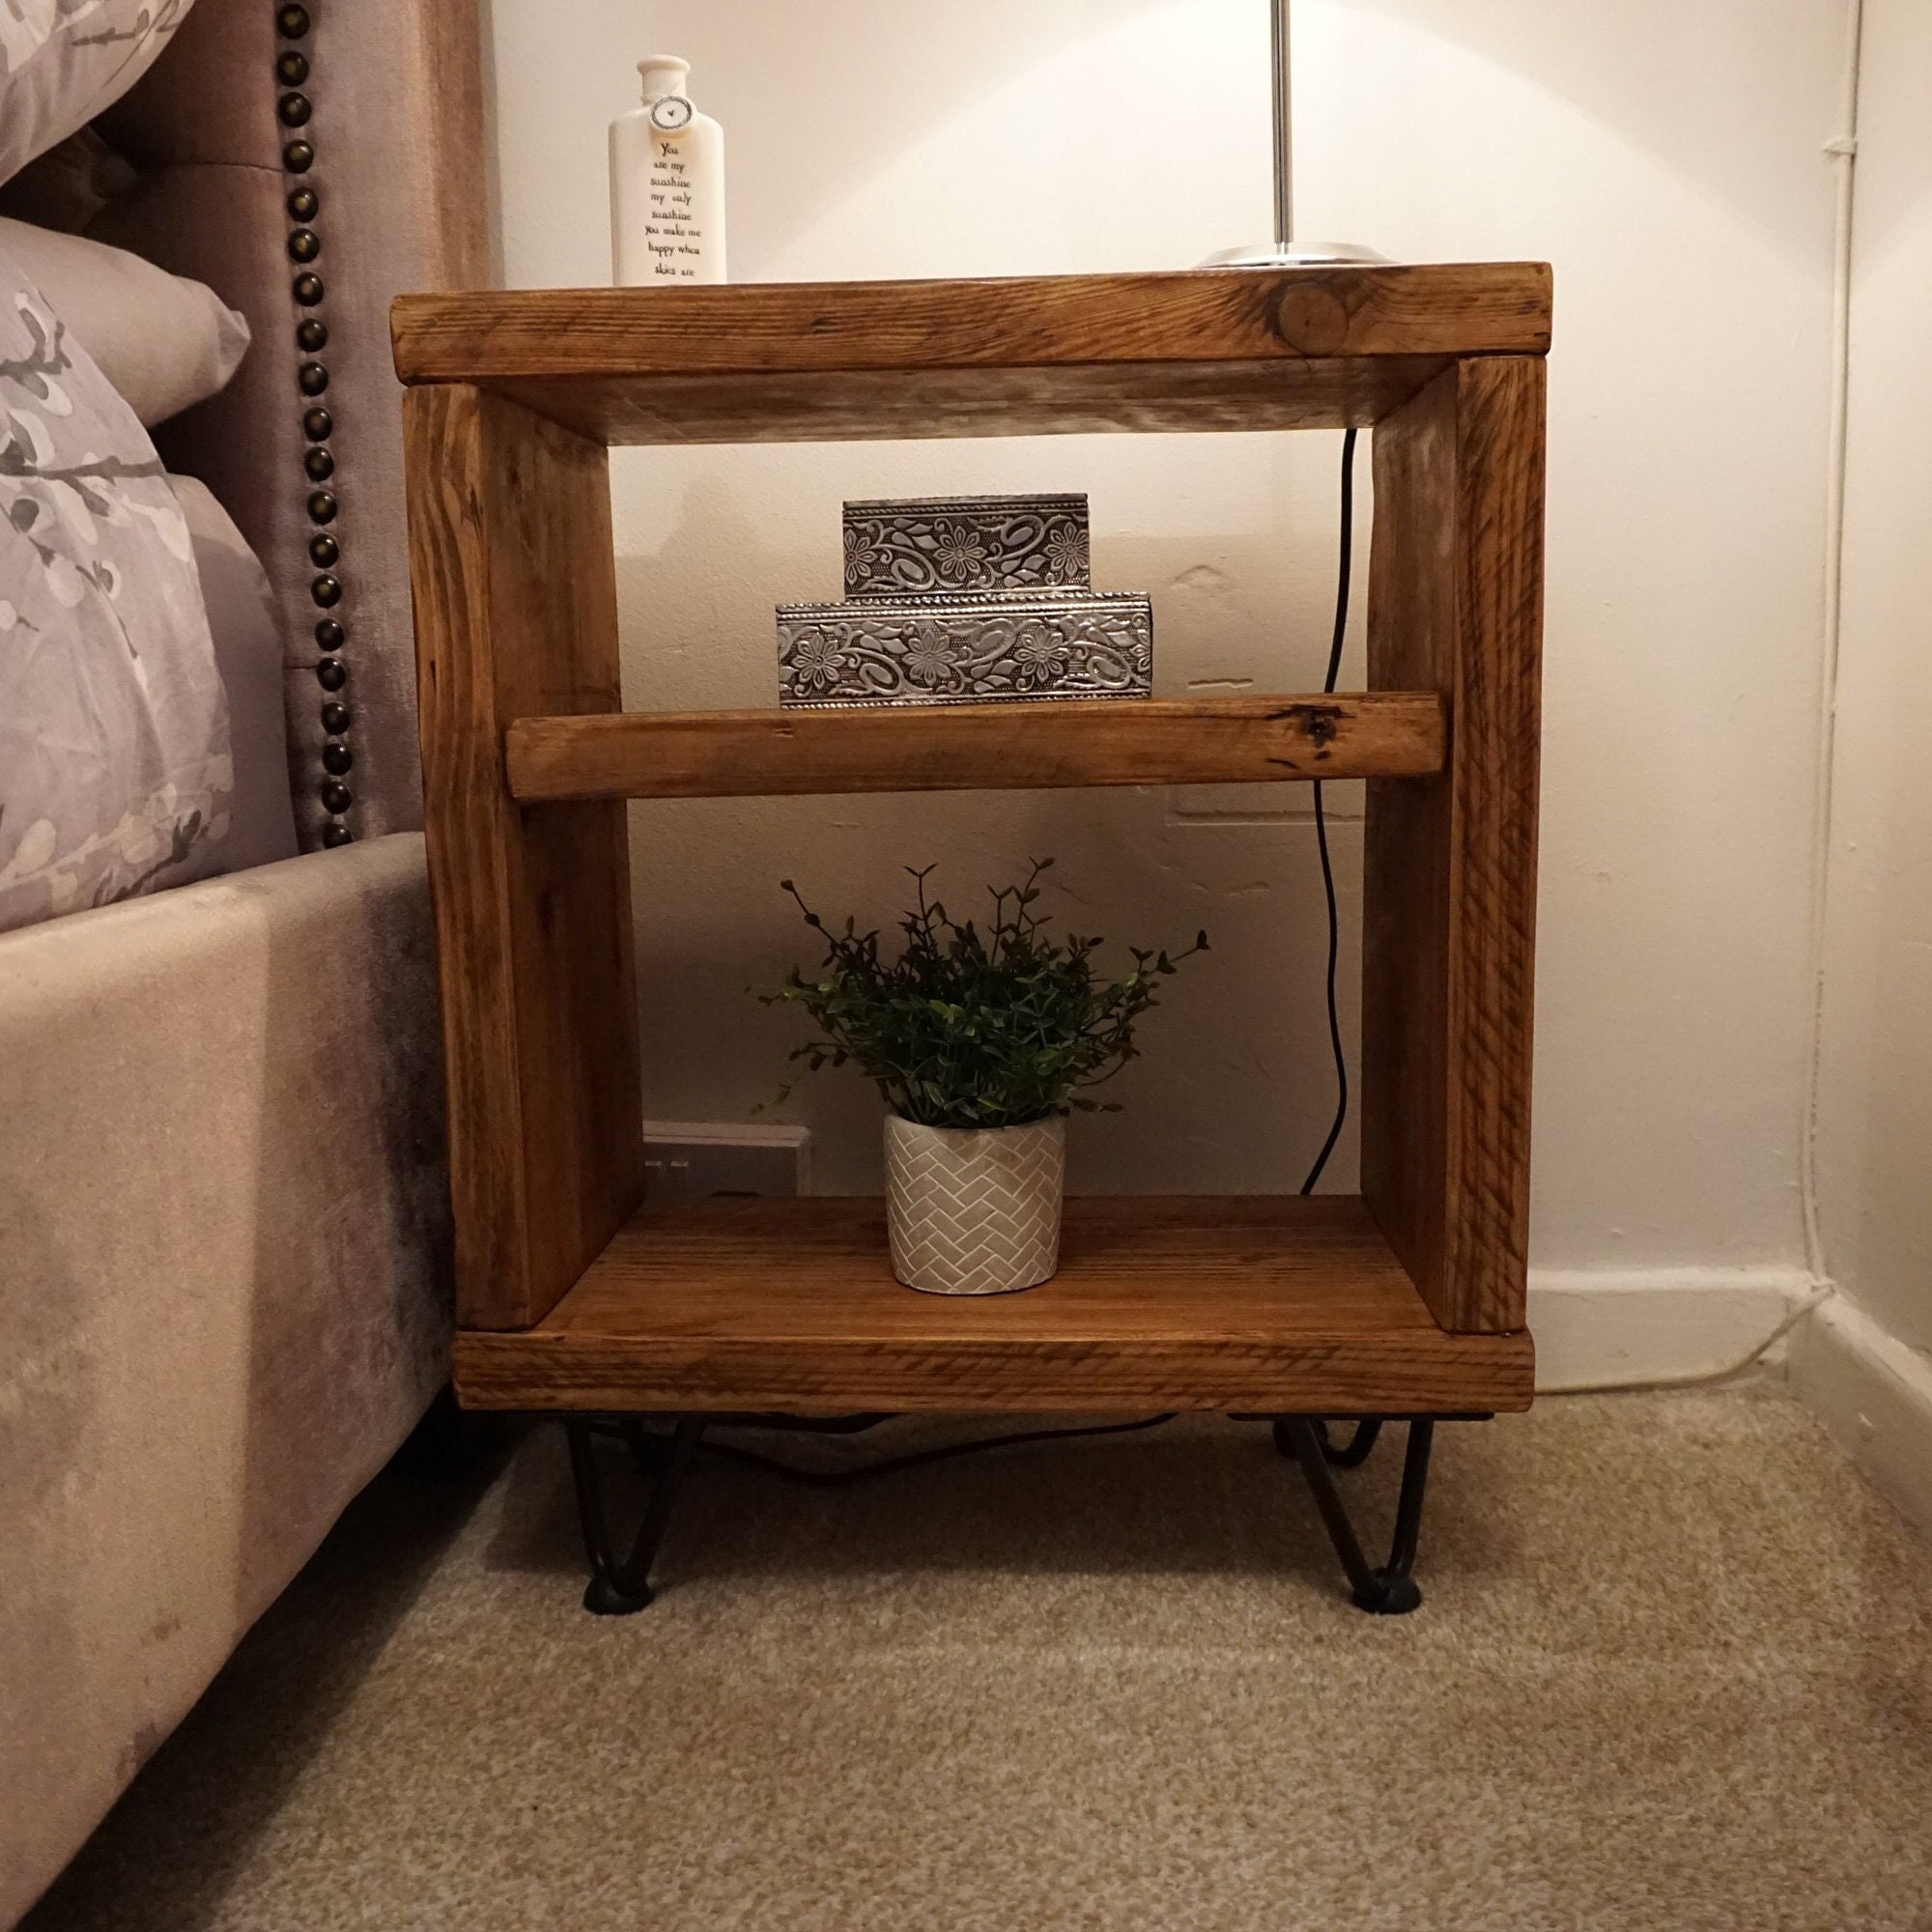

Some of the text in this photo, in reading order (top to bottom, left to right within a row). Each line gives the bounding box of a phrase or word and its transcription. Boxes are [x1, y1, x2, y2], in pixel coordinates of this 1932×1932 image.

[670, 162, 685, 174] my
[650, 177, 691, 187] sunshine
[650, 192, 692, 206] my only
[651, 209, 692, 220] sunshine
[663, 223, 686, 237] make
[648, 242, 700, 257] happy when
[655, 262, 676, 275] skies
